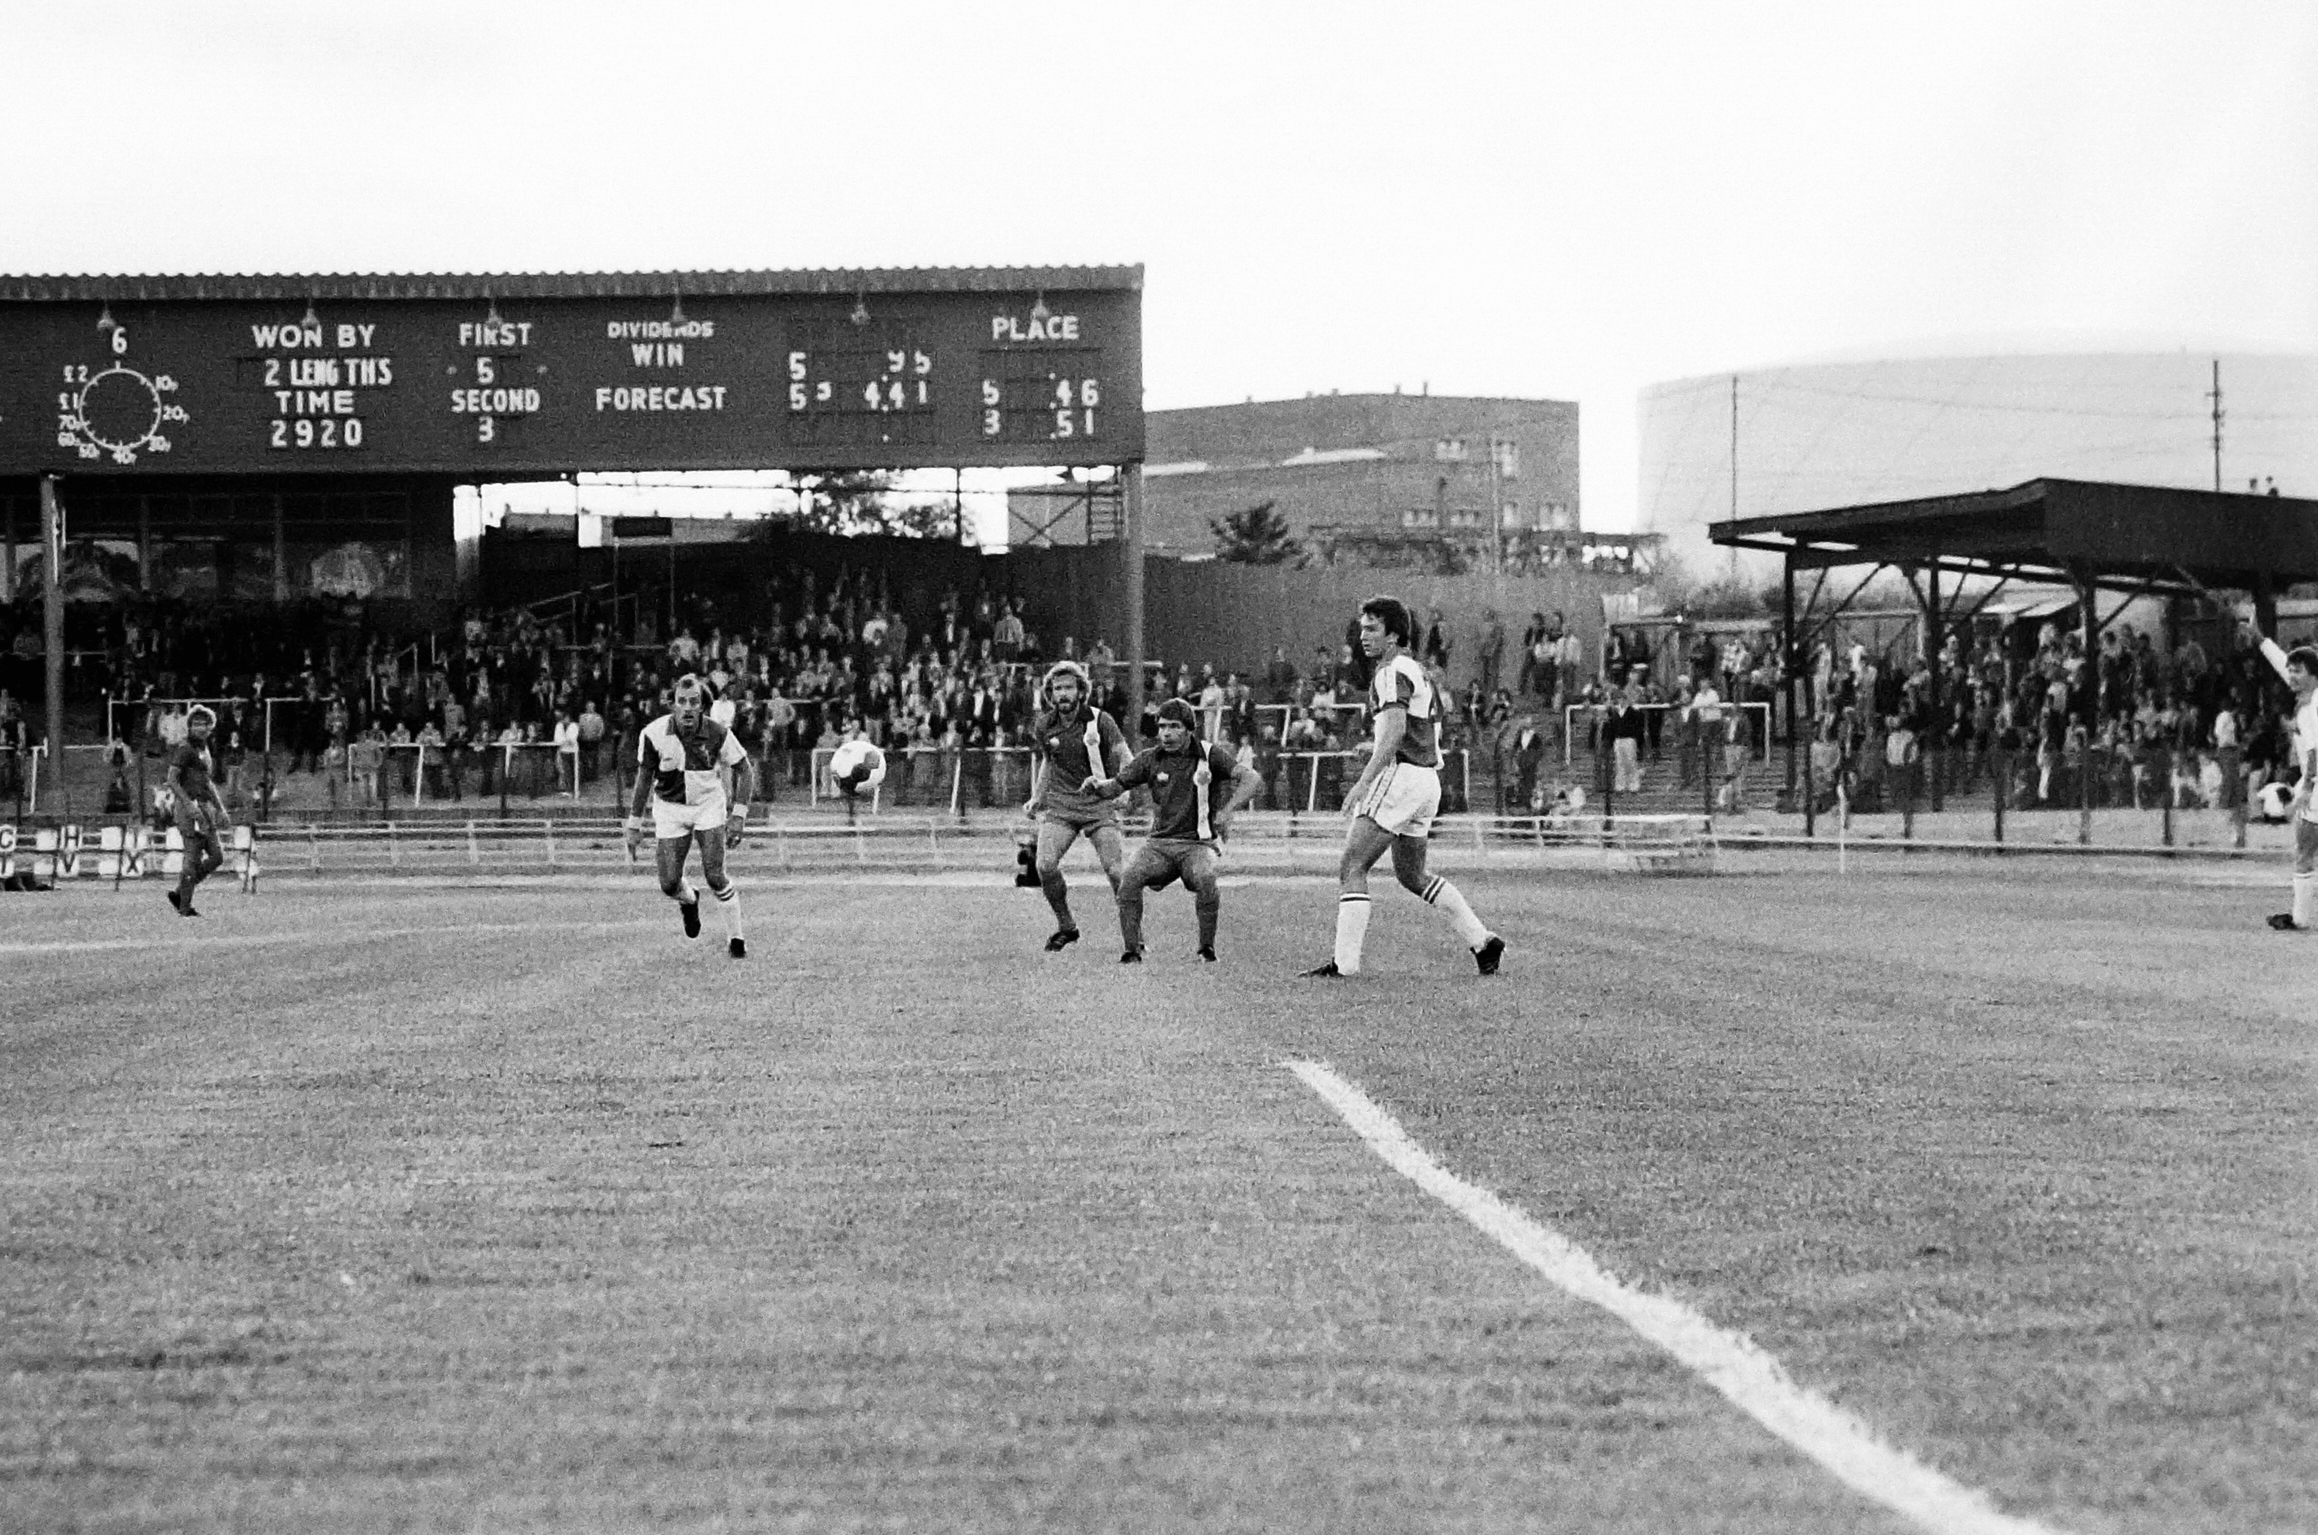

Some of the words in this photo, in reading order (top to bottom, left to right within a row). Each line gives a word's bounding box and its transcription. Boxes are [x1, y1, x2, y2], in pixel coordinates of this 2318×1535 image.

[112, 326, 127, 354] 6
[251, 324, 322, 348] WON
[338, 323, 376, 348] BY
[458, 322, 532, 347] FIRST
[993, 315, 1079, 341] PLACE
[632, 342, 684, 368] WIN
[789, 352, 806, 380] 5
[265, 358, 280, 386] 2
[477, 357, 494, 384] 5
[274, 390, 355, 415] TIME
[451, 388, 540, 413] SECOND
[596, 386, 727, 411] FORECAST
[789, 383, 807, 410] 5
[478, 416, 494, 442] 3
[984, 408, 1001, 435] 3
[65, 826, 79, 848] H
[63, 852, 76, 873] V
[126, 852, 140, 873] X
